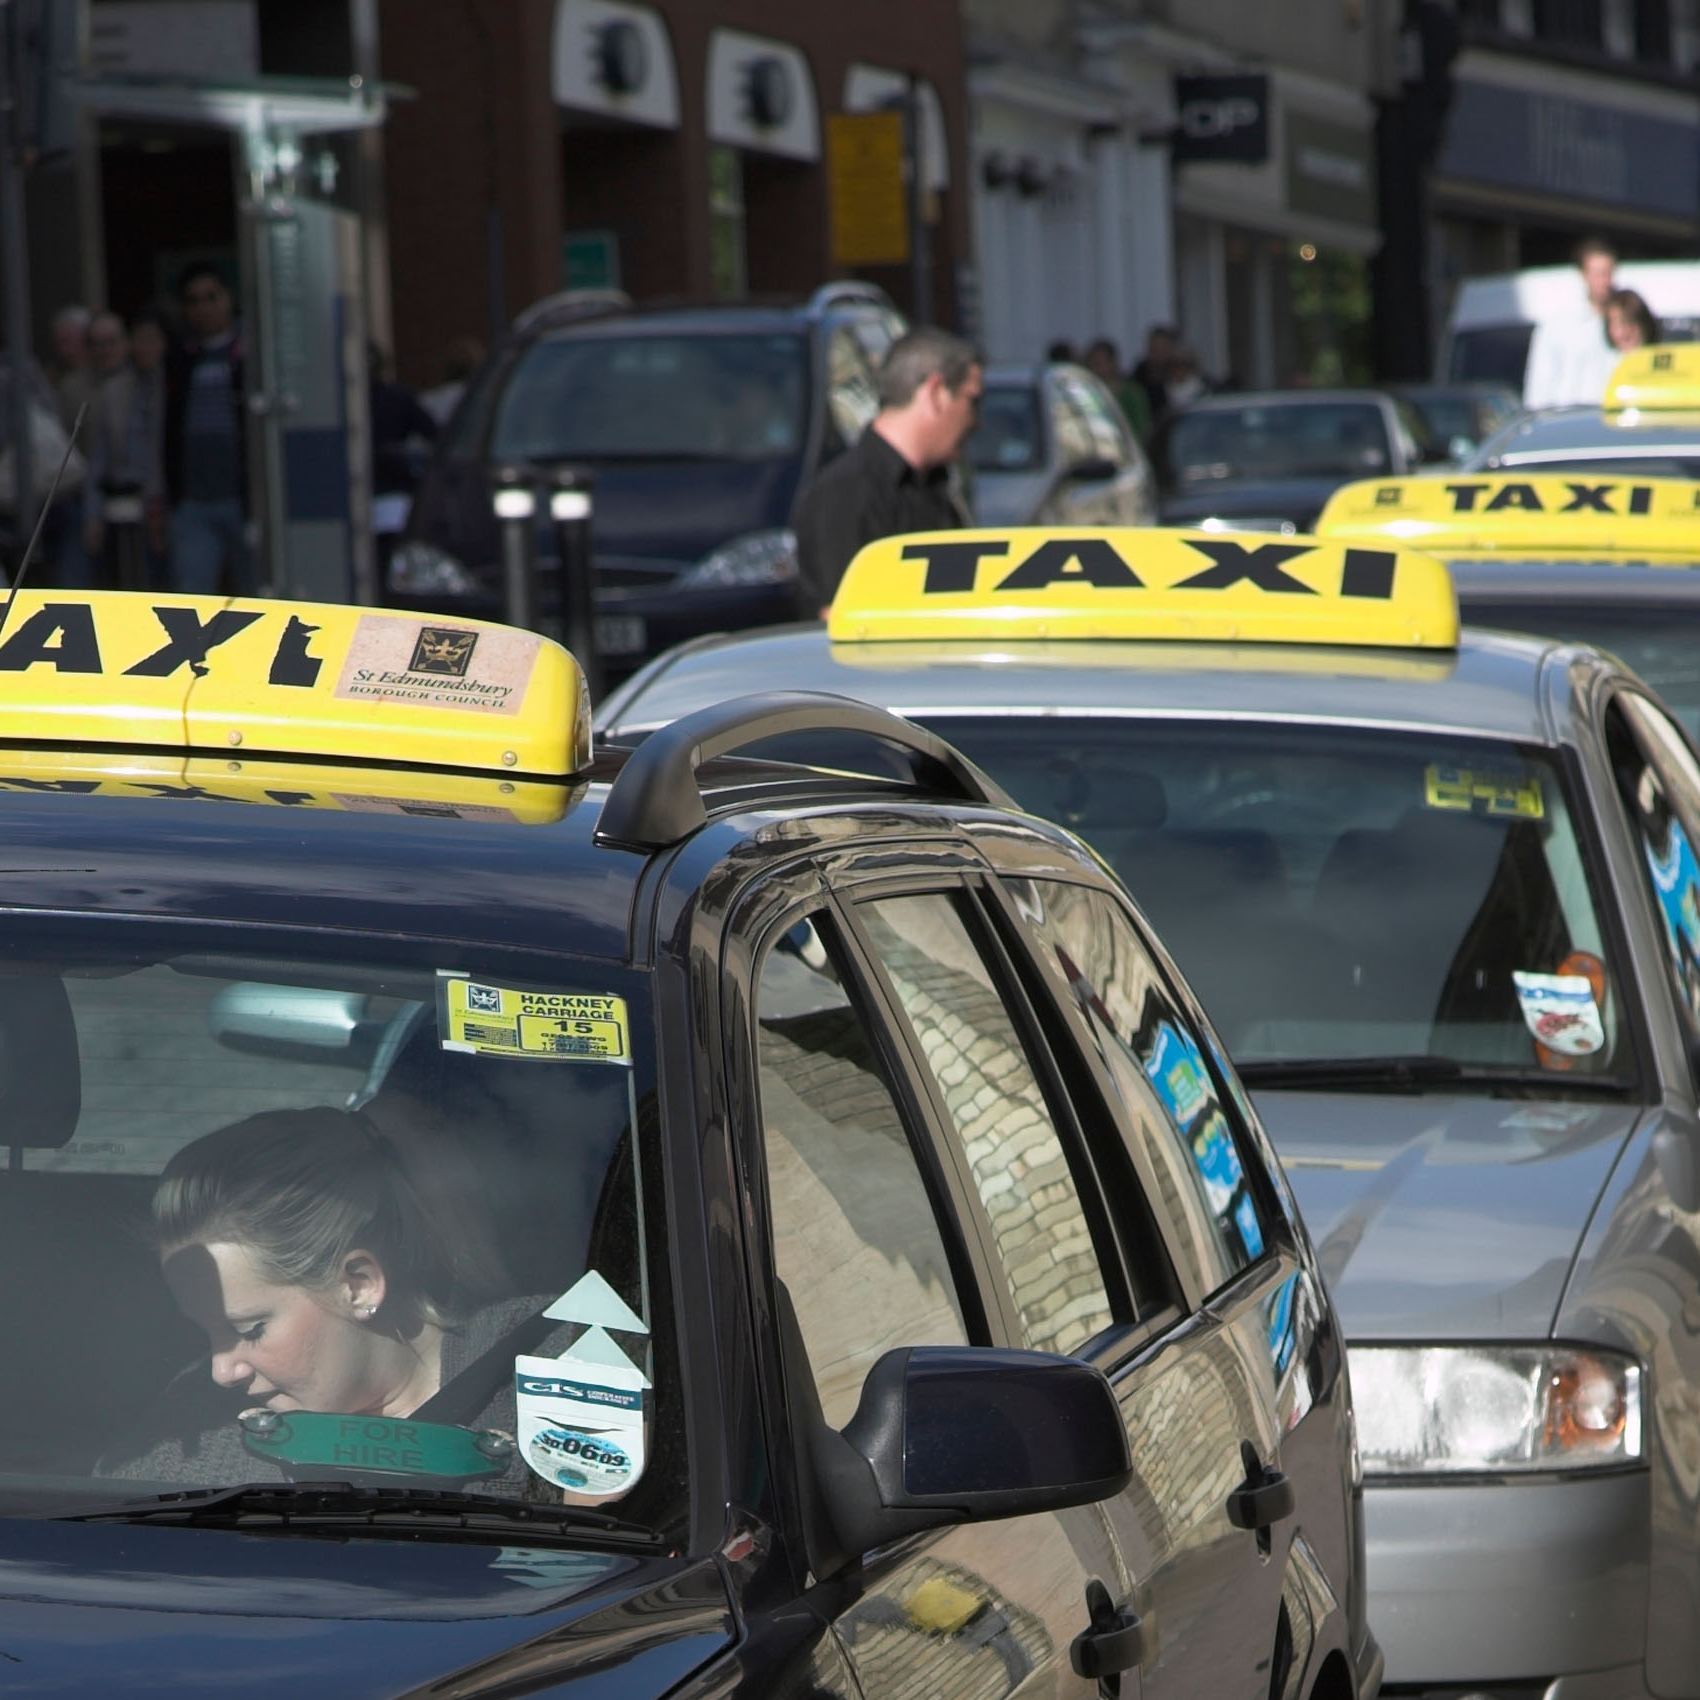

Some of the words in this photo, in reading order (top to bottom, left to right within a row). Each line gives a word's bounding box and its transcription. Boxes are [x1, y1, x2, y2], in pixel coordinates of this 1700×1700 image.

[1445, 484, 1653, 515] TAXI
[902, 540, 1400, 601] TAXI
[353, 669, 376, 682] St
[379, 671, 513, 698] Edmundsbury
[349, 685, 430, 700] BOROUGH
[434, 693, 507, 708] COUNCIL
[521, 994, 614, 1010] HACKNEY
[522, 1005, 614, 1020] CARRIAGE
[554, 1020, 594, 1034] 15
[340, 1420, 420, 1443] FOR
[333, 1443, 424, 1467] HIRE
